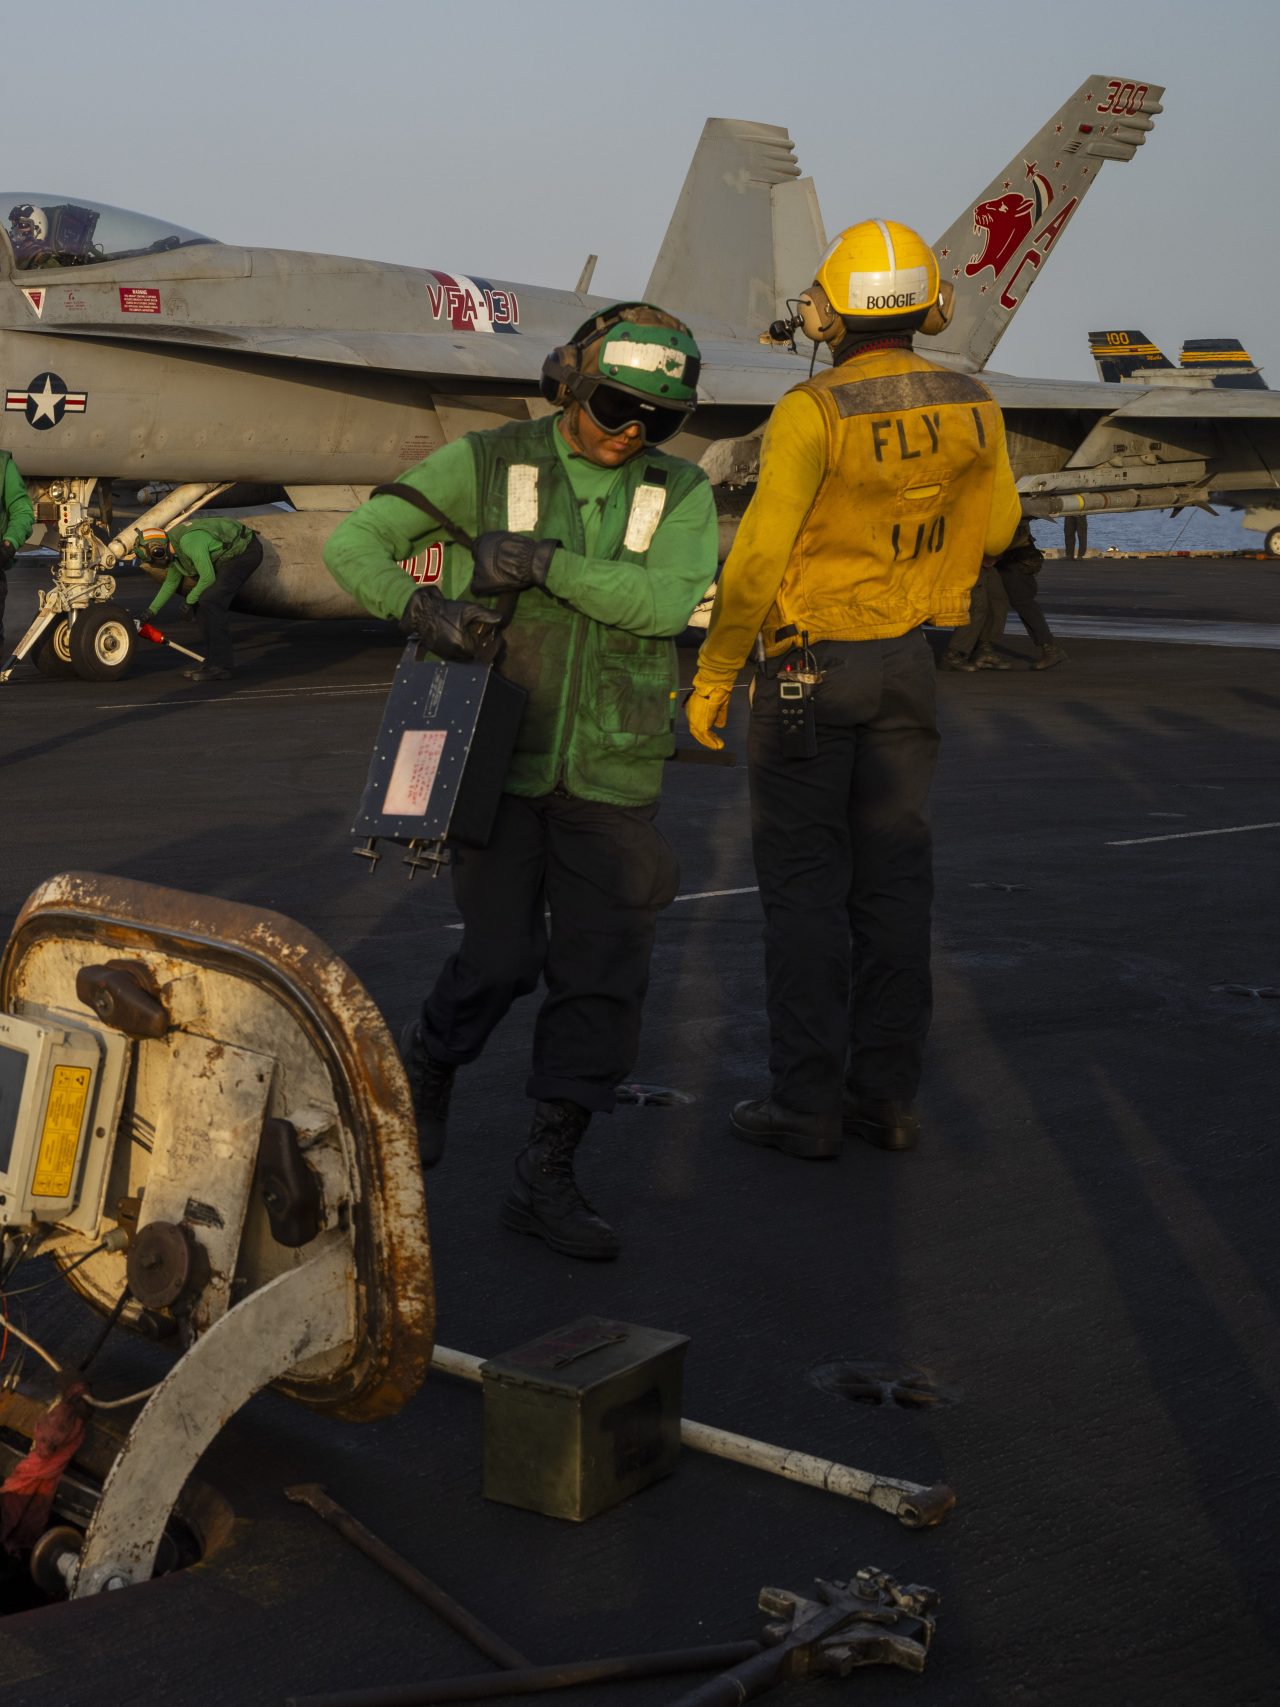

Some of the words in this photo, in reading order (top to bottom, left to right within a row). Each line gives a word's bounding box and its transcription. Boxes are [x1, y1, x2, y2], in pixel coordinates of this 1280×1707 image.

[1096, 79, 1149, 116] 300
[425, 284, 520, 325] VFA-131
[867, 292, 916, 310] BOOGIE
[1105, 332, 1130, 345] 100
[871, 412, 940, 462] FLY
